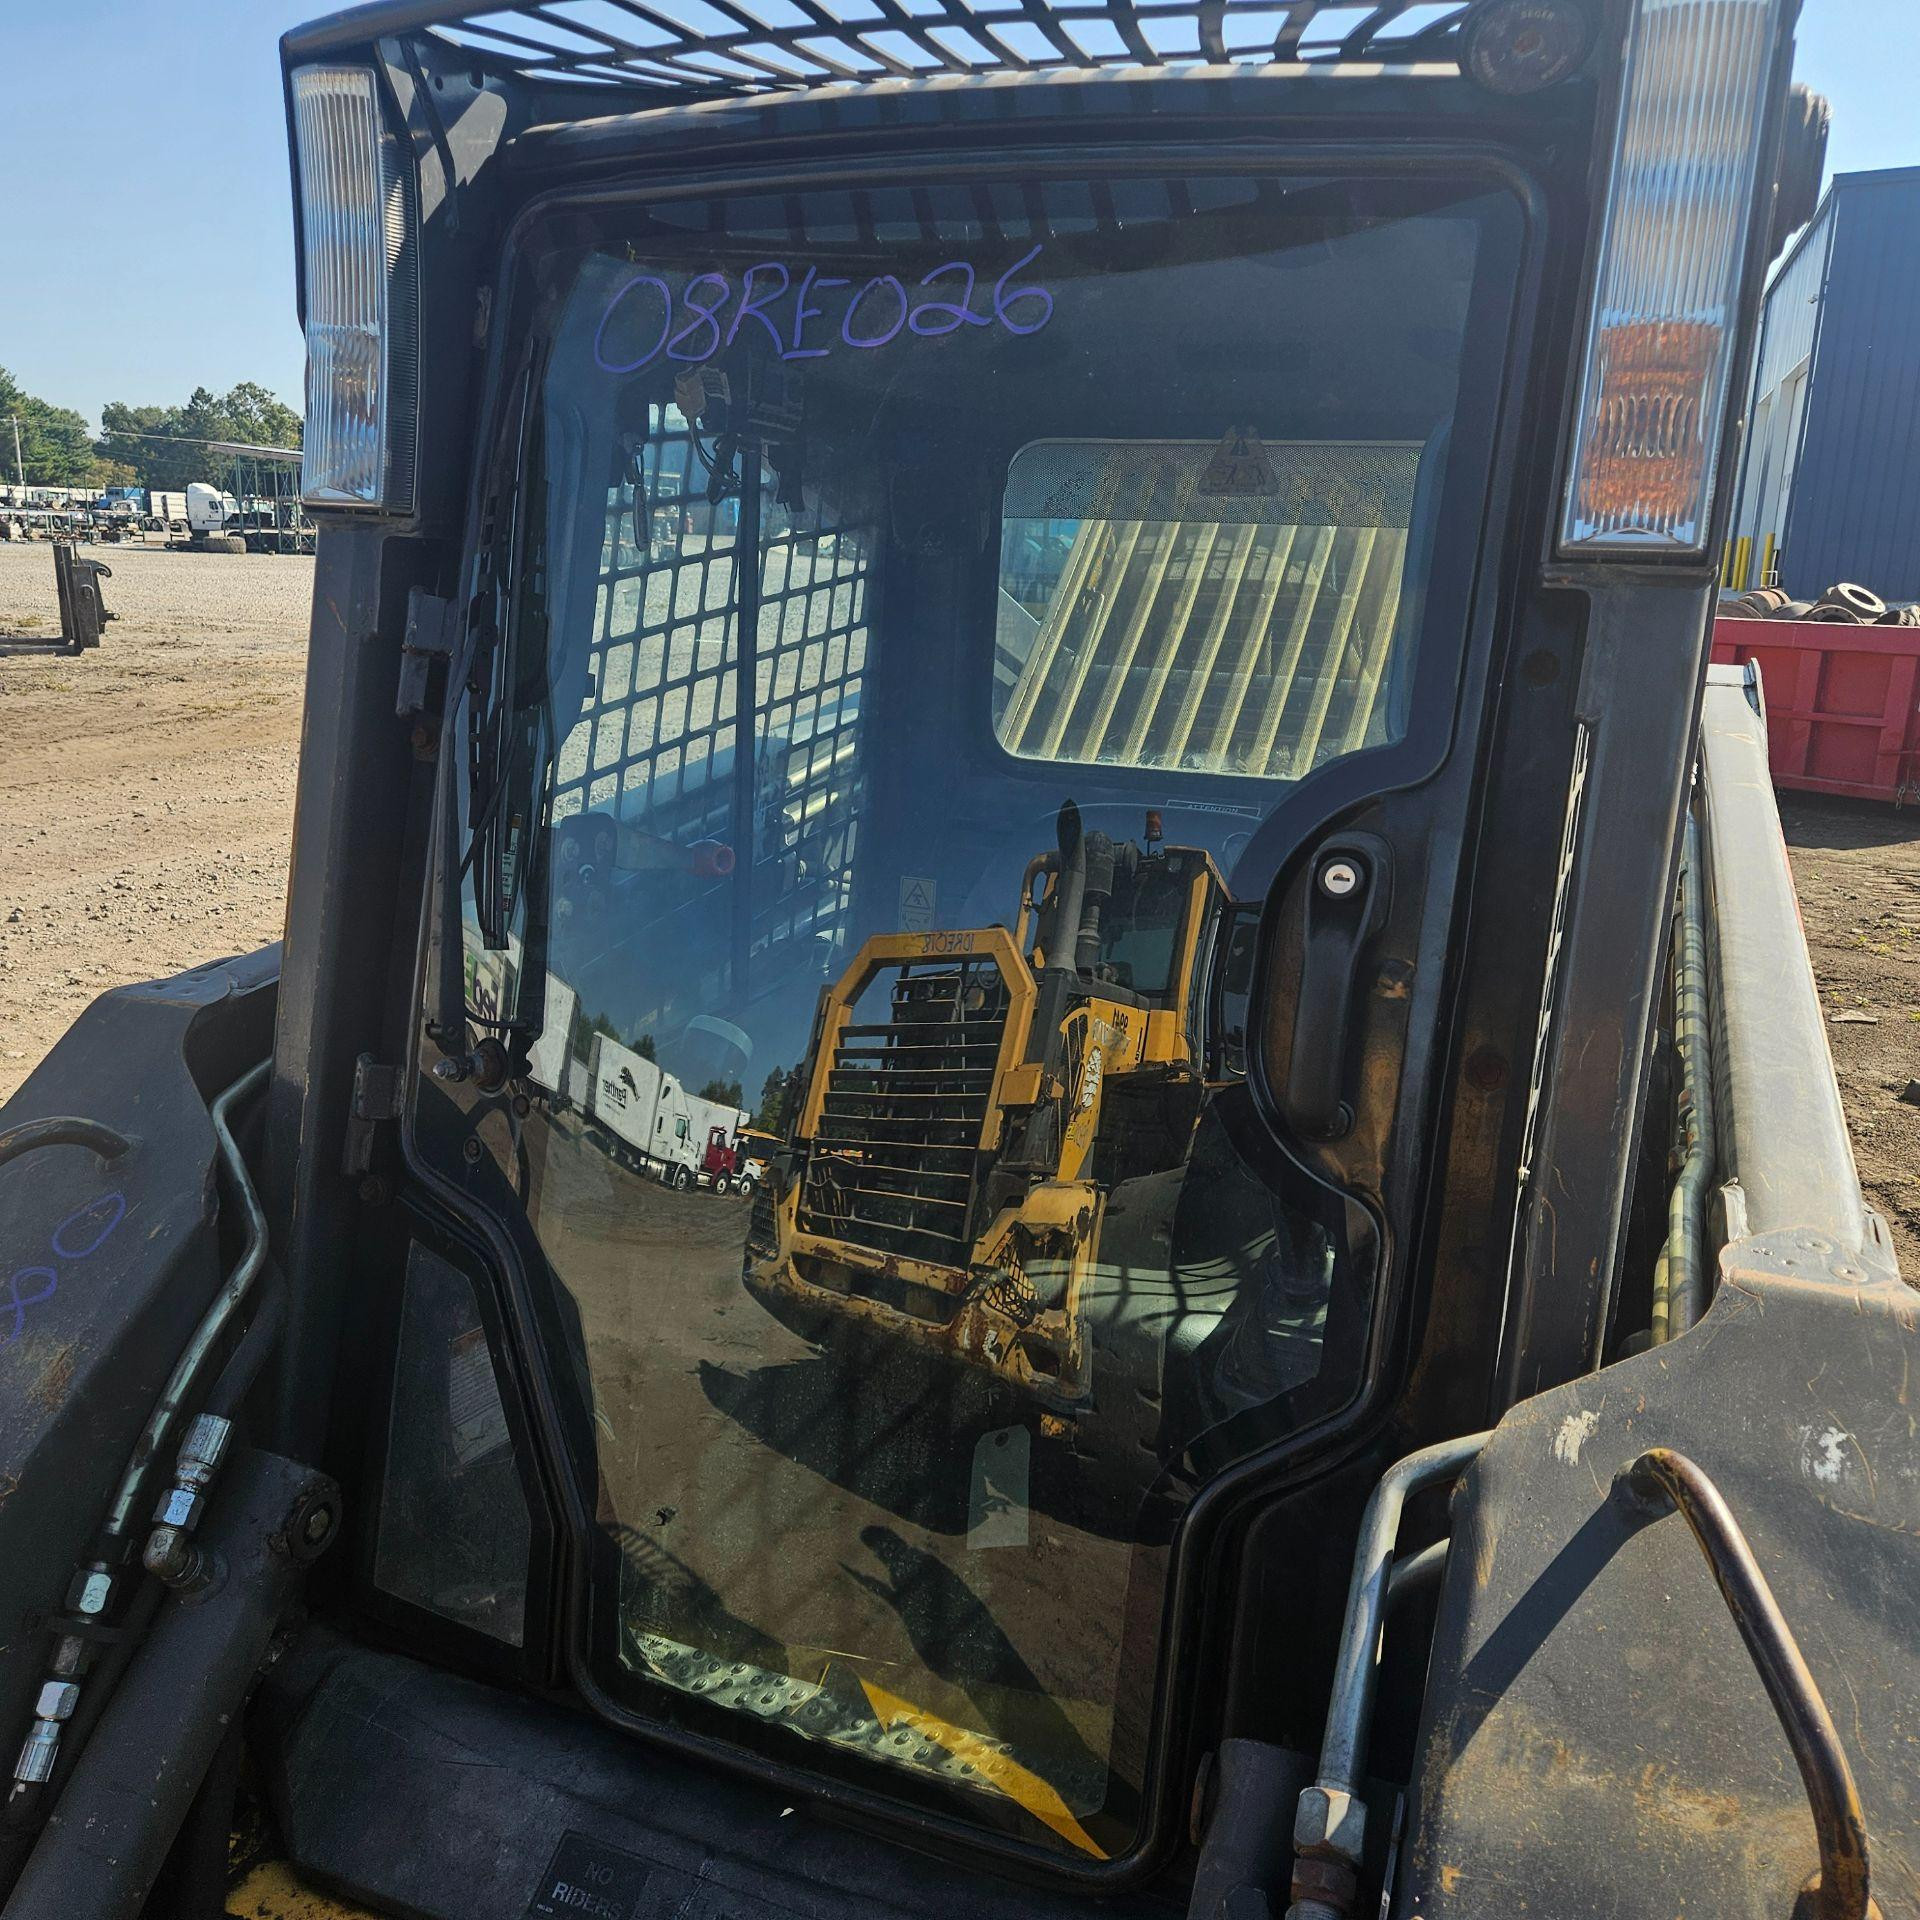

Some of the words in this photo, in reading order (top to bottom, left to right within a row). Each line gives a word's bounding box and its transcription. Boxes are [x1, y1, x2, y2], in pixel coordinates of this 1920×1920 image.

[594, 244, 1054, 373] 08RE026
[584, 1861, 614, 1885] NO
[551, 1881, 623, 1919] RIDERS
